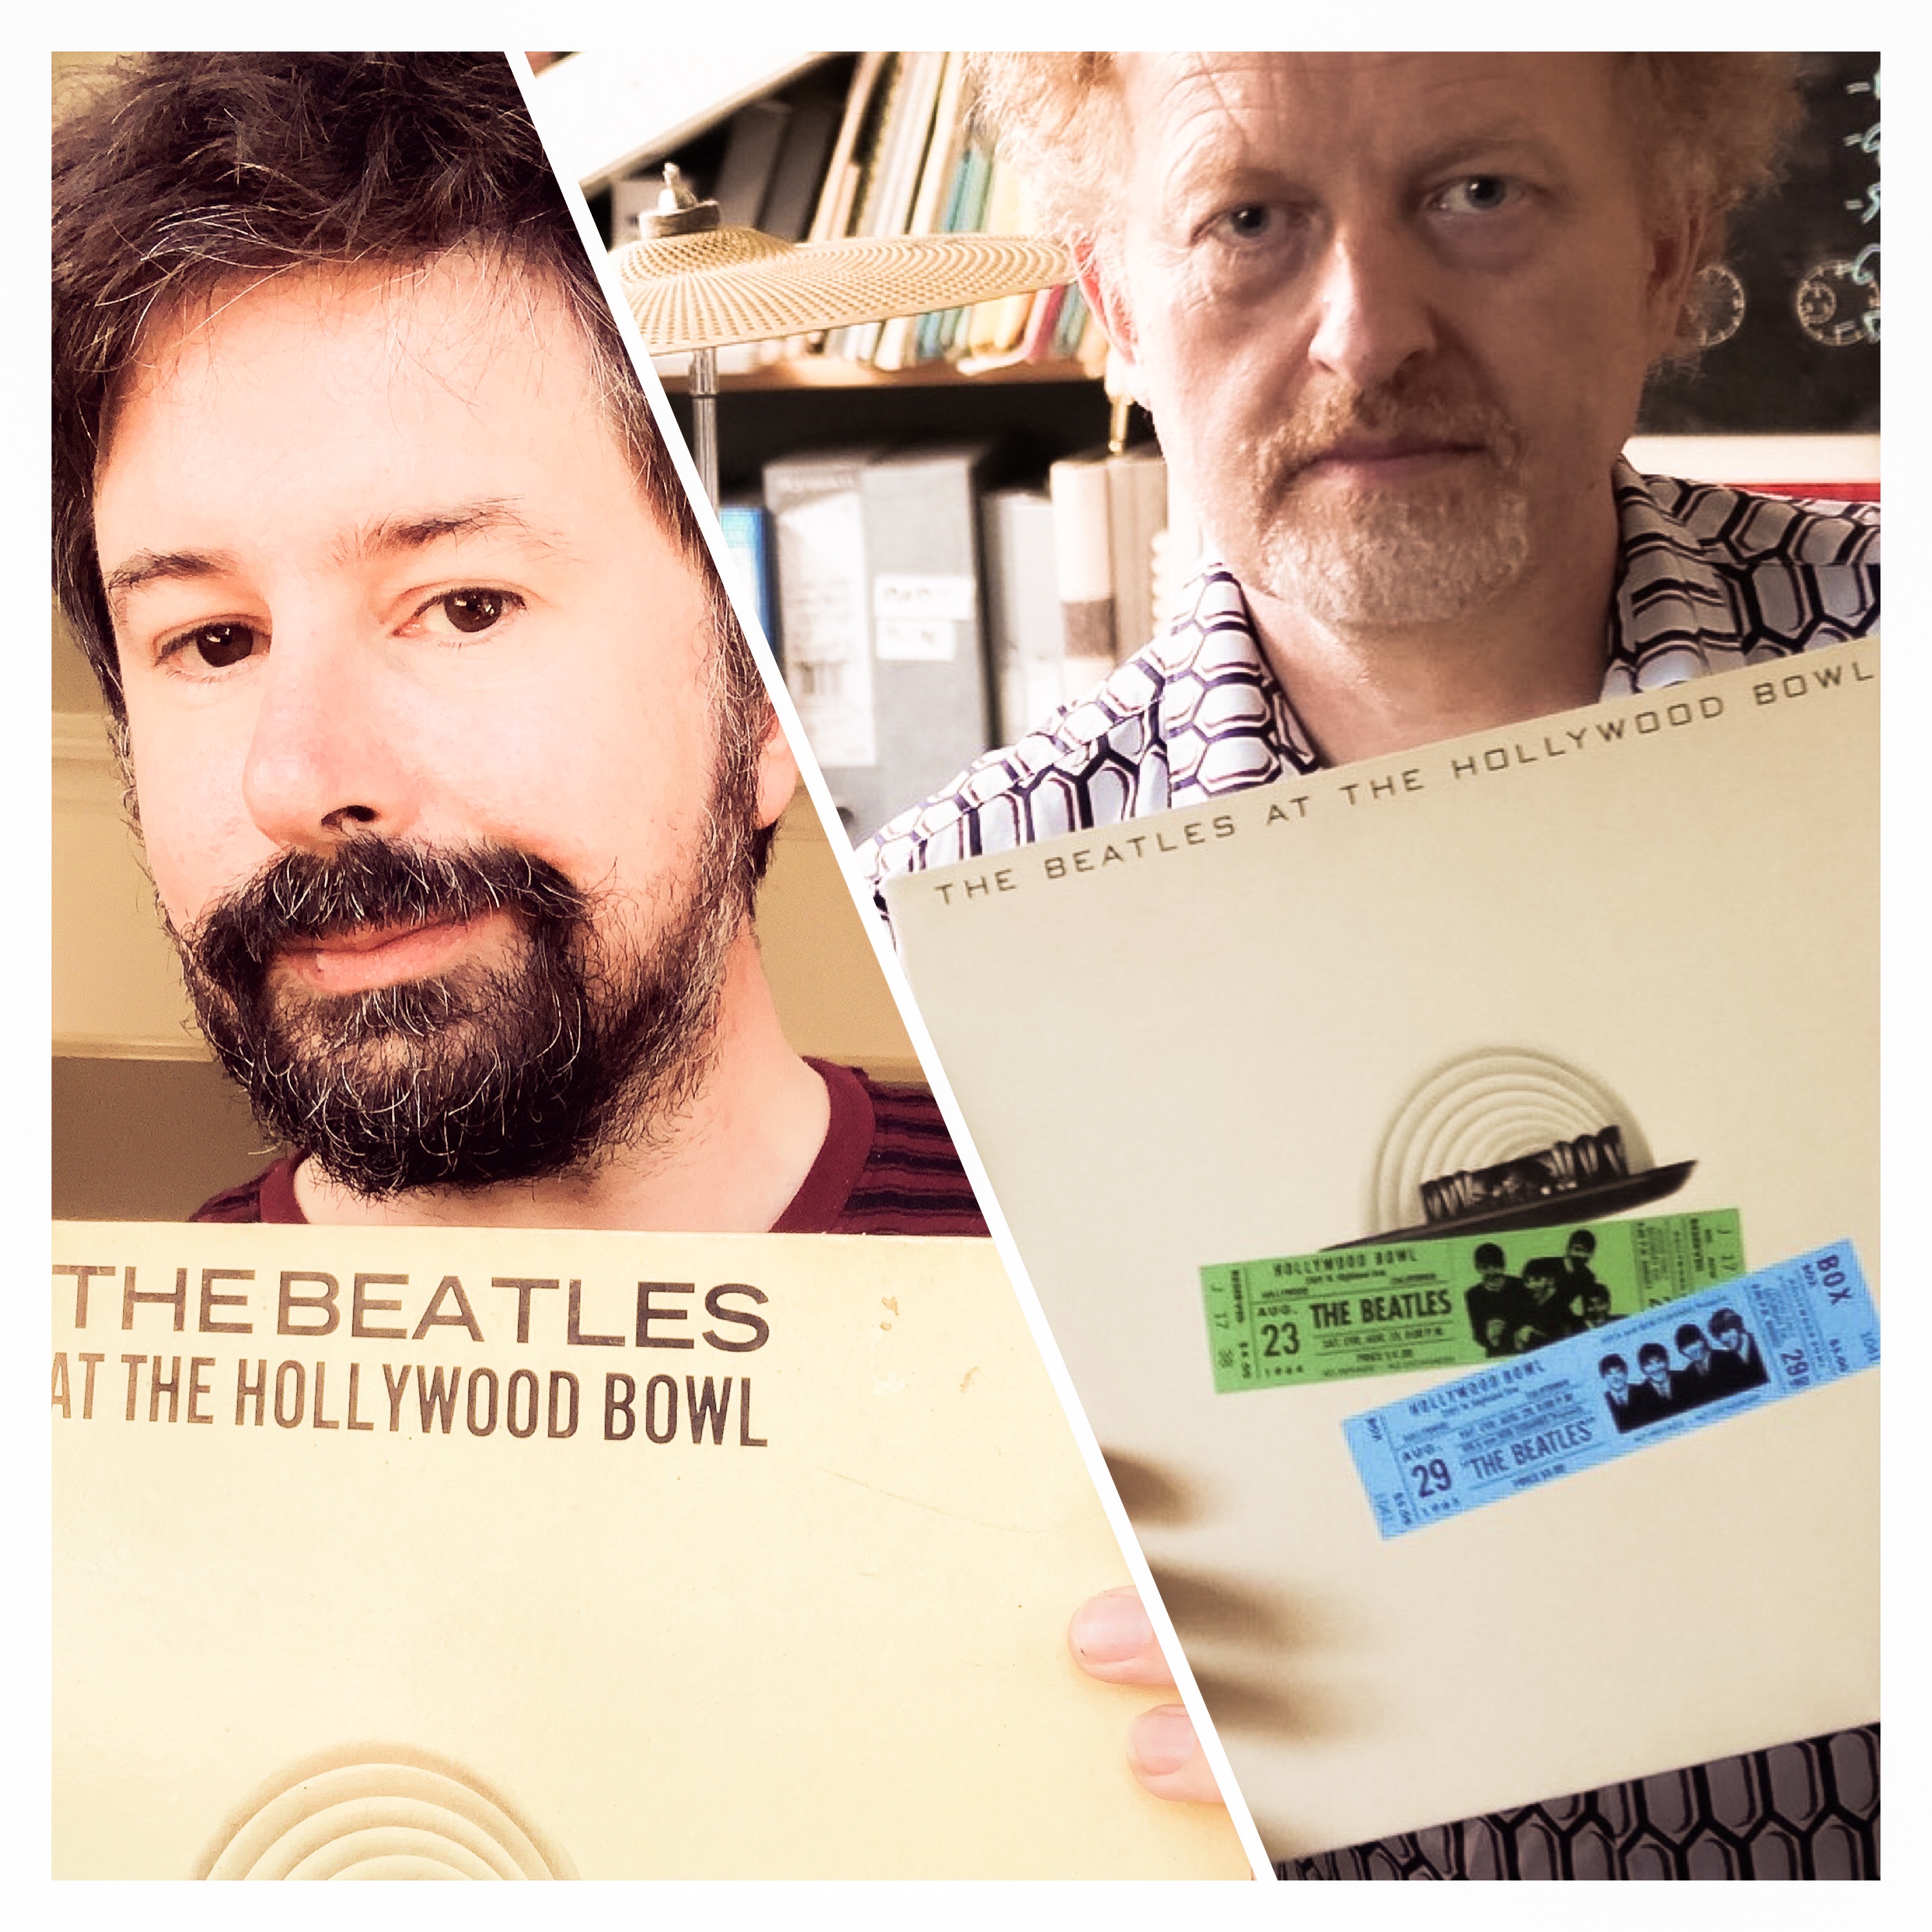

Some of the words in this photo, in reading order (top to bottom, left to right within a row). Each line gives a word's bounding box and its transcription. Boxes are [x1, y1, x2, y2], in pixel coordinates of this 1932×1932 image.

[933, 868, 1018, 905] THE
[1044, 814, 1236, 880] BEATLES
[1266, 795, 1310, 826] AT
[1338, 768, 1425, 806] THE
[1450, 696, 1724, 779] HOLLYWOOD
[1752, 661, 1875, 706] BOWL
[1273, 1253, 1366, 1276] HOLLYWOOD
[1374, 1248, 1418, 1267] BOWL
[1816, 1255, 1853, 1305] BOX
[53, 1264, 256, 1334] THE
[276, 1271, 770, 1353] BEATLES
[1309, 1300, 1351, 1330] THE
[1359, 1289, 1453, 1323] BEATLES
[1260, 1322, 1300, 1357] 23
[53, 1352, 105, 1419] AT
[121, 1354, 216, 1425] THE
[234, 1358, 580, 1439] HOLLYWOOD
[603, 1372, 769, 1448] BOWL
[1411, 1459, 1452, 1497] 29
